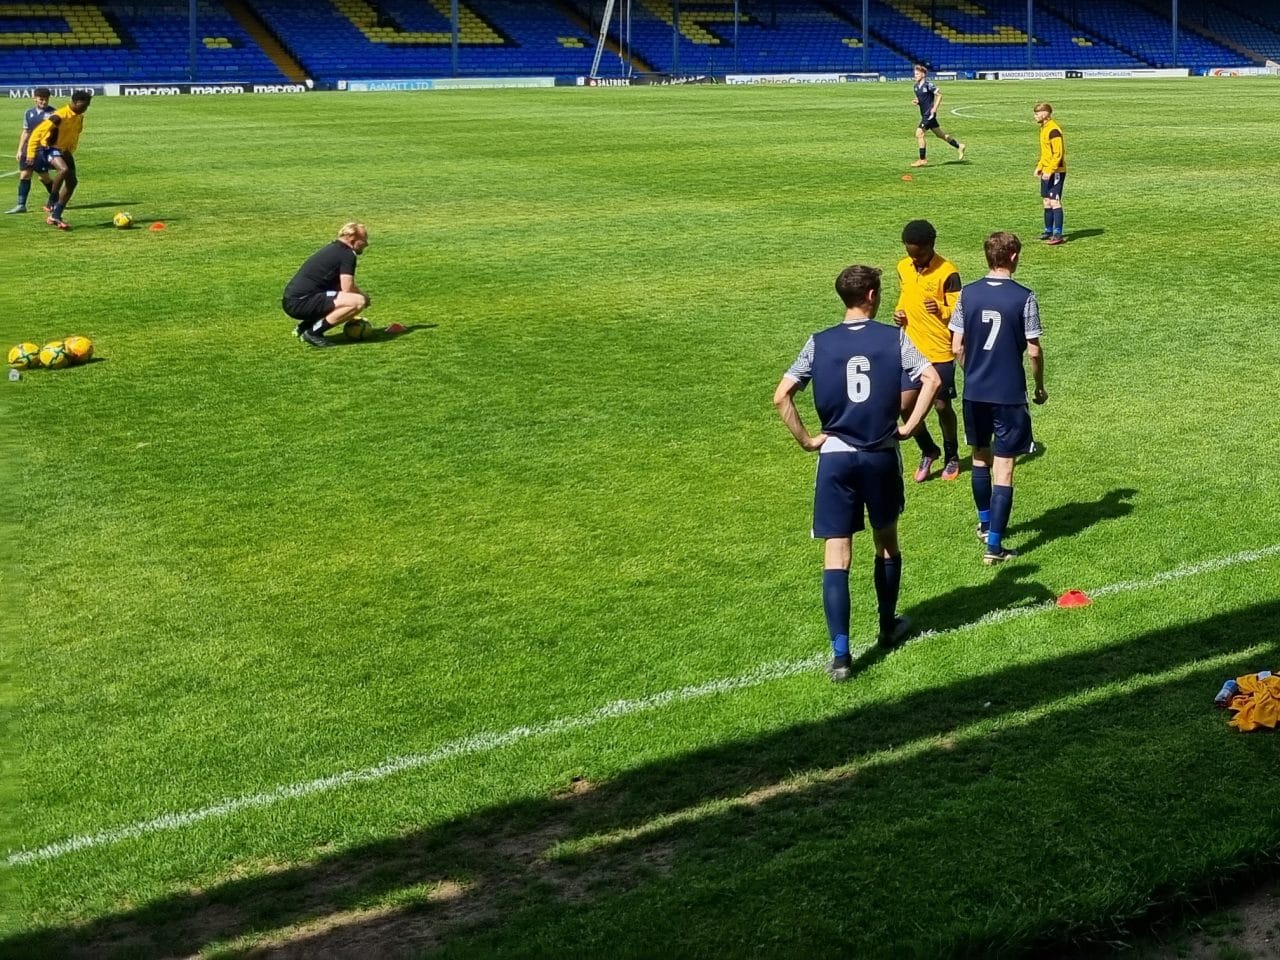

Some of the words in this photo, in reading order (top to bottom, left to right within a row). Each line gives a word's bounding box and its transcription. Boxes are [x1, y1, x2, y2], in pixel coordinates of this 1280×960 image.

[411, 82, 429, 90] LTD
[982, 310, 1001, 350] 7
[846, 356, 870, 403] 6
